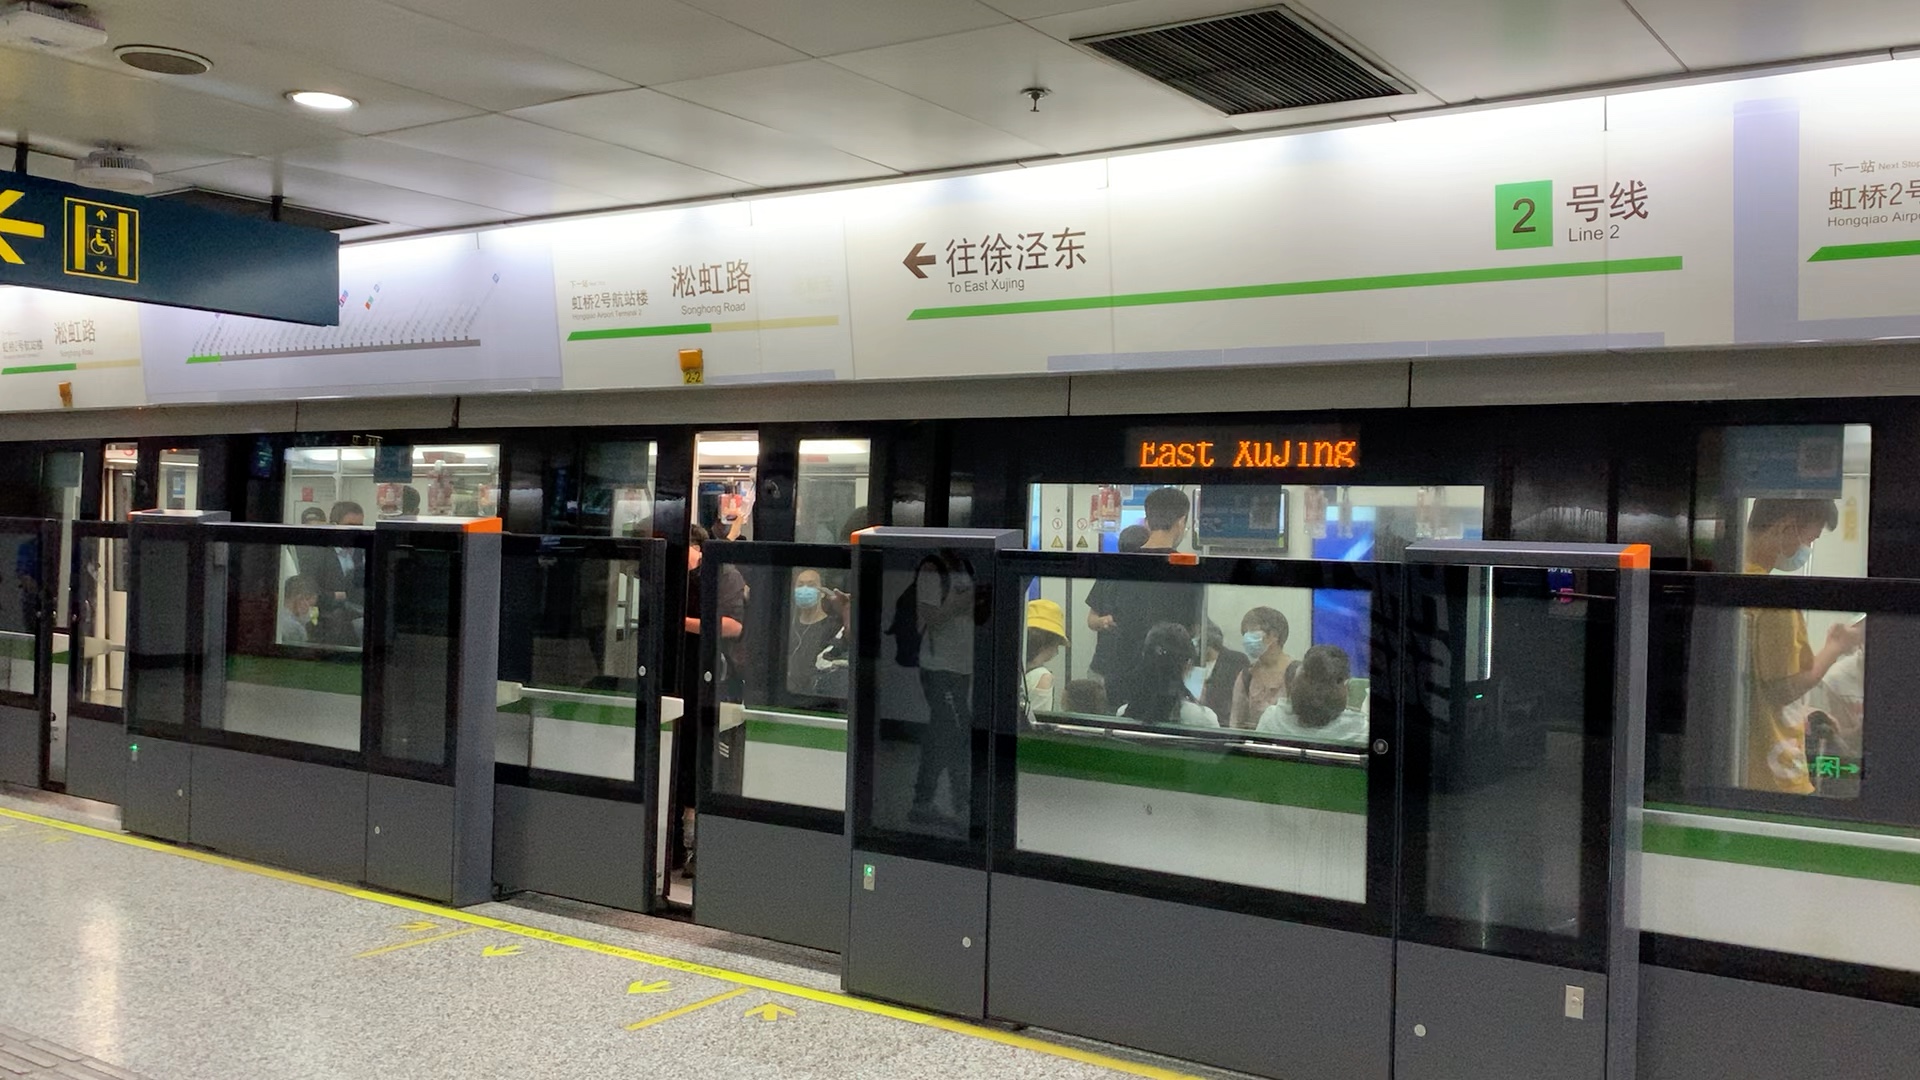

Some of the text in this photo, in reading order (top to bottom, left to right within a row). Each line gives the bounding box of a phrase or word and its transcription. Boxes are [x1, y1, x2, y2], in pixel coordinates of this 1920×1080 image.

[1828, 160, 1876, 177] 下一站
[1878, 162, 1900, 170] Next
[1566, 179, 1649, 223] 号线
[1512, 197, 1537, 234] 2
[1827, 214, 1889, 228] Hongqiao
[1568, 224, 1620, 242] Line 2
[945, 226, 1087, 278] 往徐泾东
[671, 259, 752, 299] 淞虹路
[947, 278, 1025, 293] To East Xujing
[681, 302, 746, 317] Songhong Road
[54, 319, 96, 345] 淞虹路
[685, 371, 701, 384] 2-2
[1140, 440, 1215, 467] East
